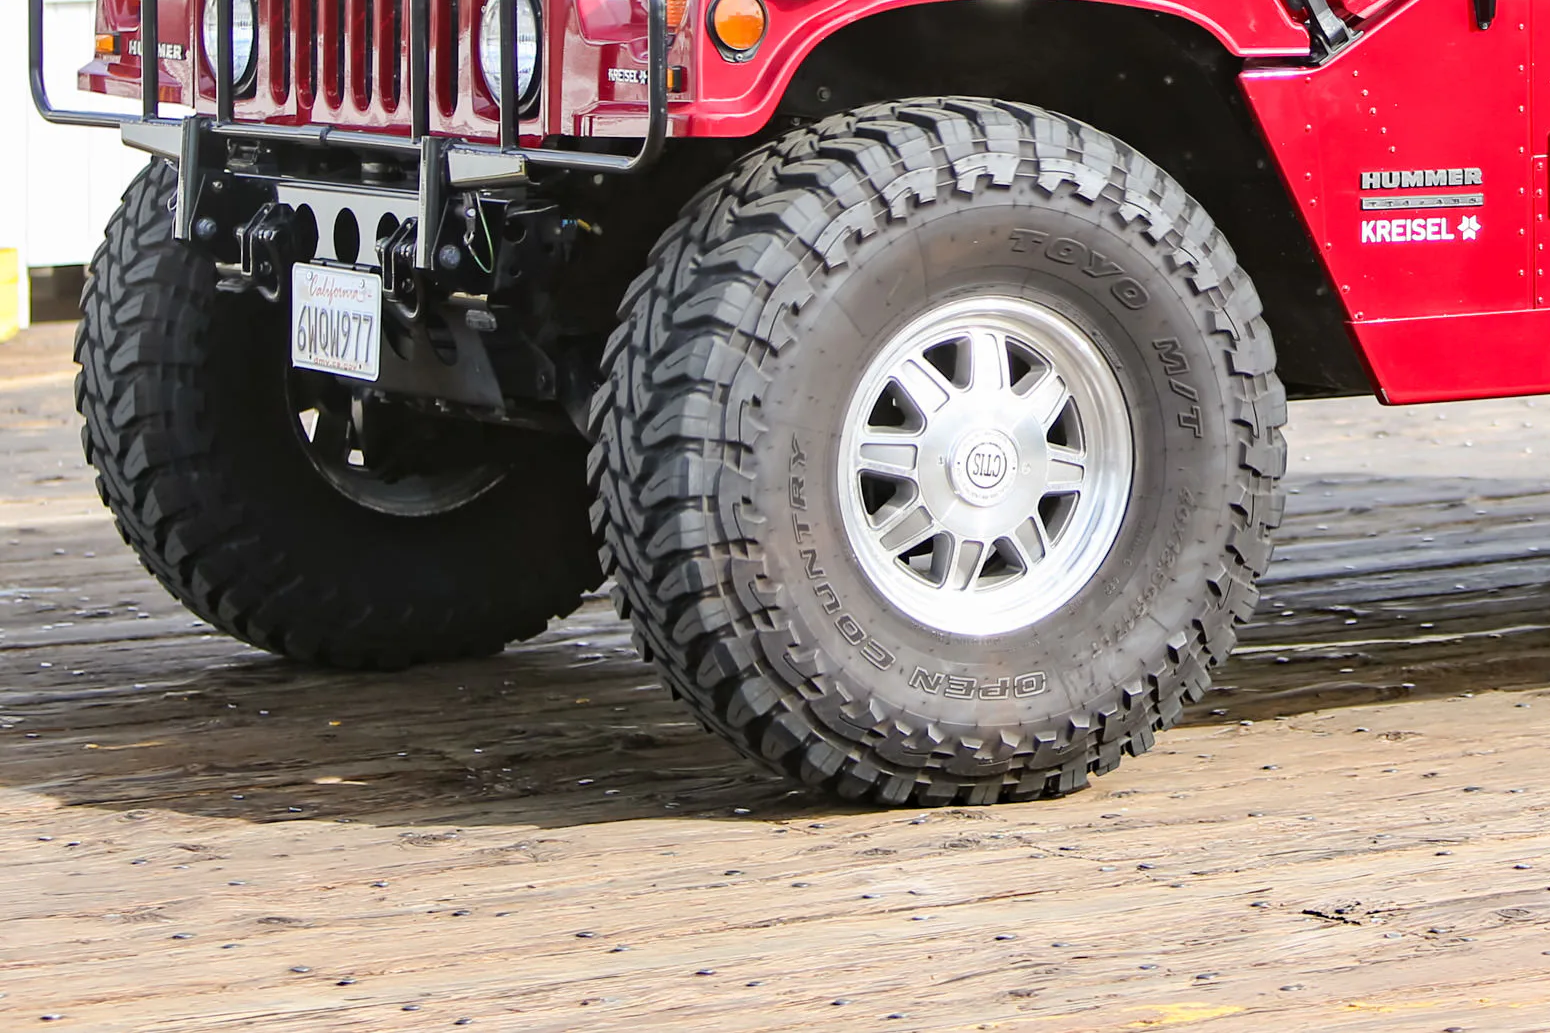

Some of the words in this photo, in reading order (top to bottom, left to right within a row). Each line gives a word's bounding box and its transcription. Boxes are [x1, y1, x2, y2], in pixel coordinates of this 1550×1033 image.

[128, 40, 182, 60] HUMER
[1361, 167, 1483, 190] HUMMER
[1361, 216, 1455, 243] KREISEL
[310, 274, 360, 305] California
[297, 305, 373, 363] 6WQW977
[1009, 227, 1151, 310] TOYO
[1151, 337, 1203, 439] M/T
[973, 453, 1002, 478] CTIS
[787, 431, 897, 671] COUNTRY
[908, 665, 1047, 700] OPEN
